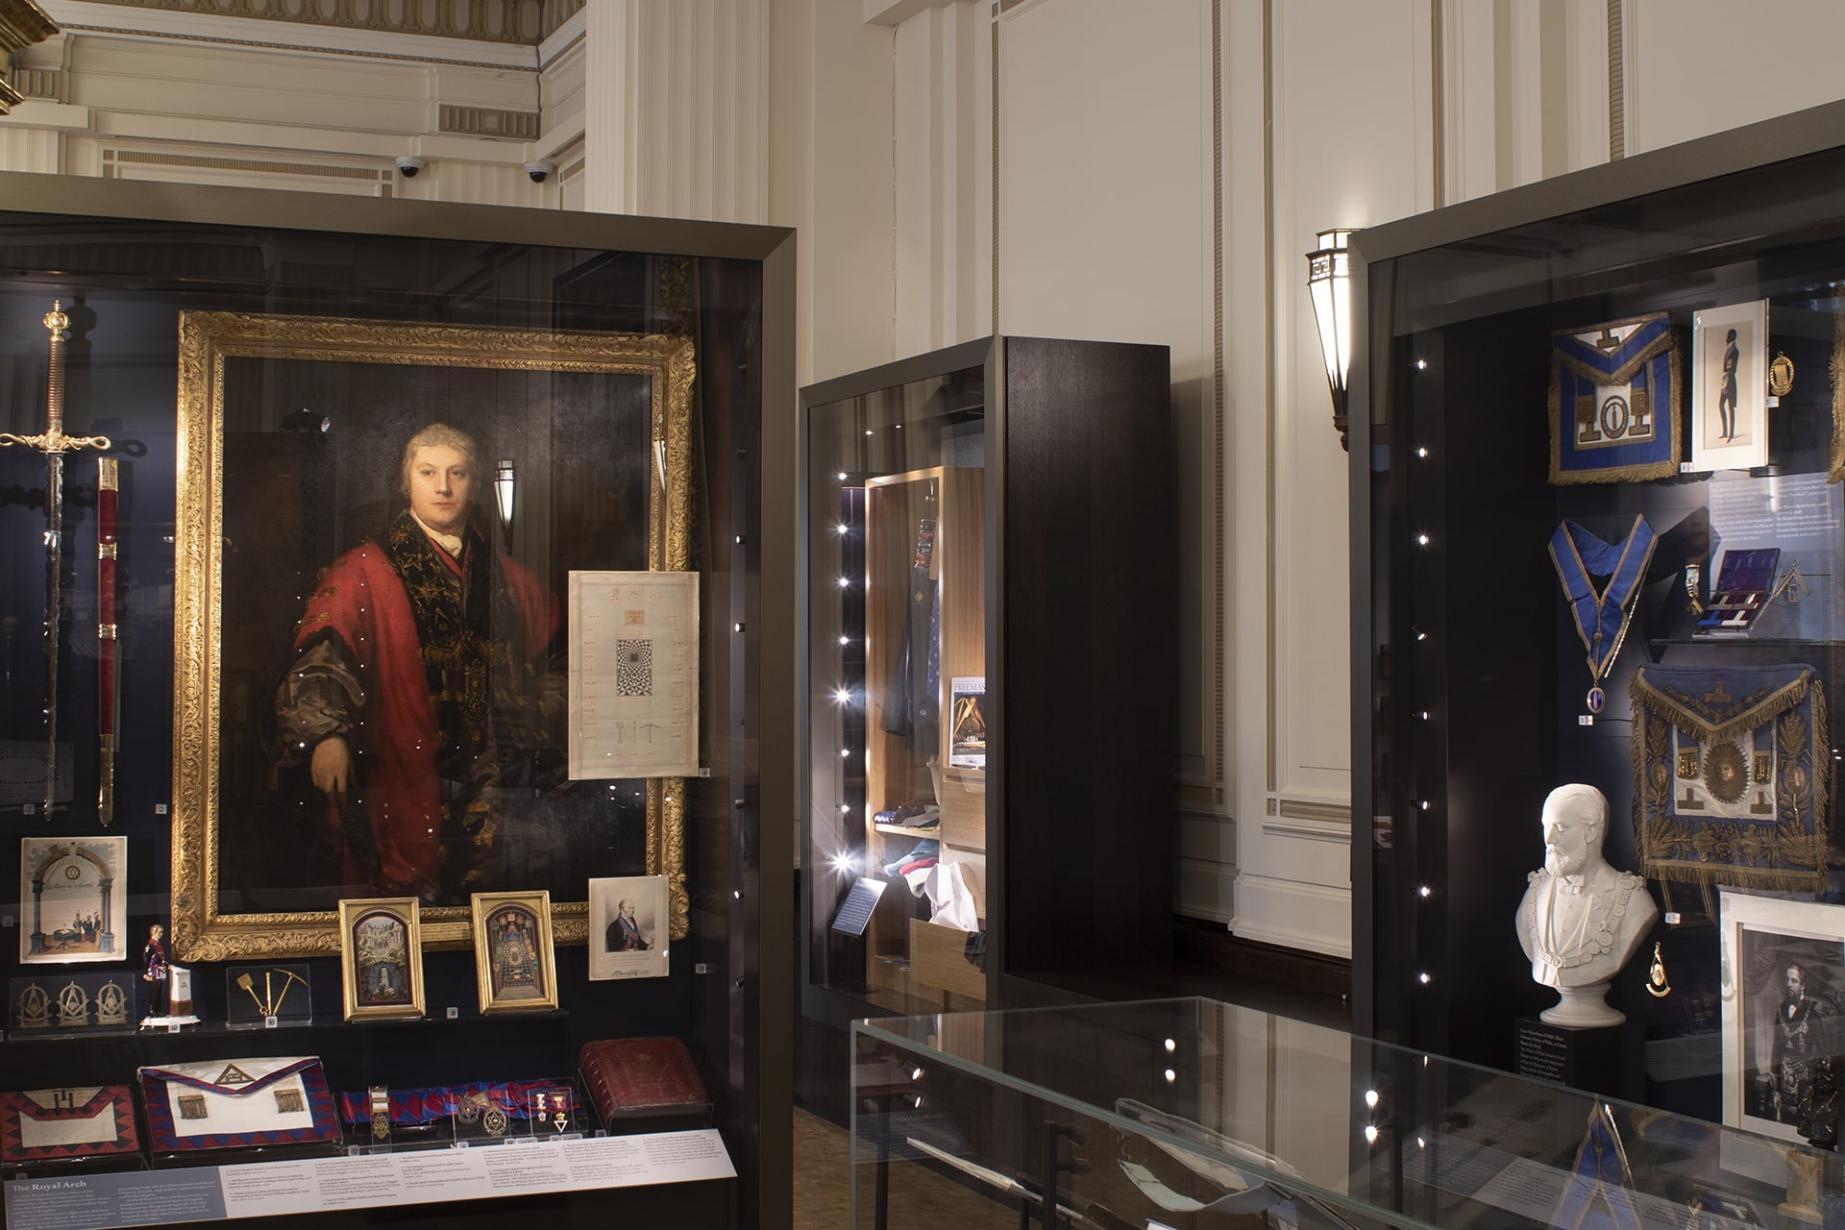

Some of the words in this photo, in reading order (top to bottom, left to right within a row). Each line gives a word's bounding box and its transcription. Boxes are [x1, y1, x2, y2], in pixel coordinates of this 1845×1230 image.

[14, 1184, 30, 1192] The
[32, 1181, 61, 1191] Royal
[63, 1180, 87, 1189] Arch
